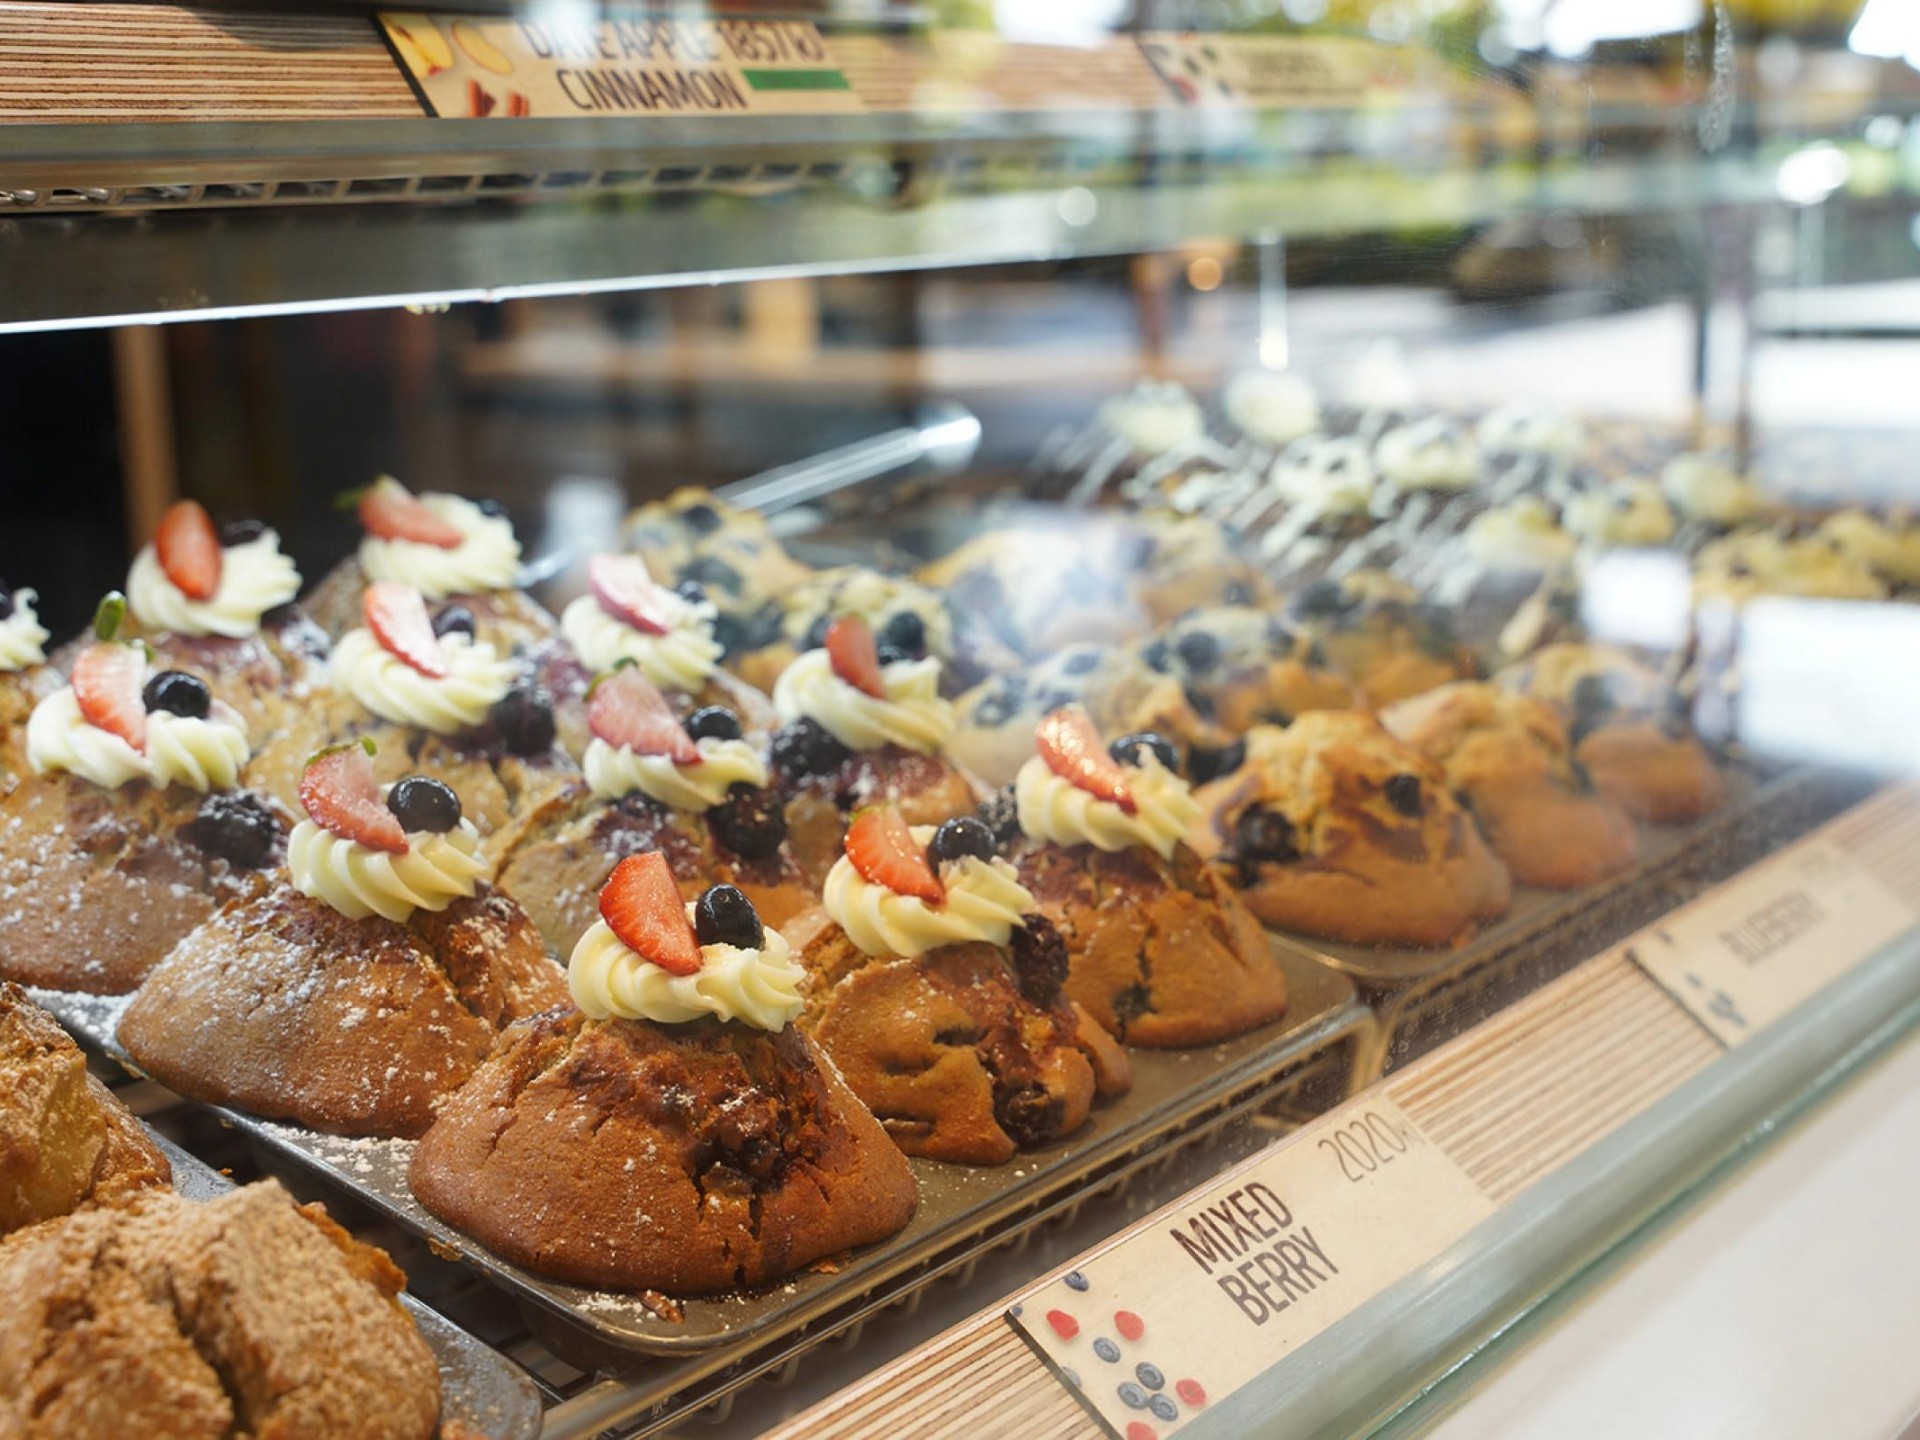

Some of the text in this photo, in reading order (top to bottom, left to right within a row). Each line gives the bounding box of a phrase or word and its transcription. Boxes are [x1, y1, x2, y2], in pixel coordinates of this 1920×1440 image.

[557, 68, 748, 109] CINNAMON
[1318, 1111, 1407, 1182] 2020
[1169, 1182, 1293, 1275] MIXED
[1217, 1226, 1339, 1326] BERRY
